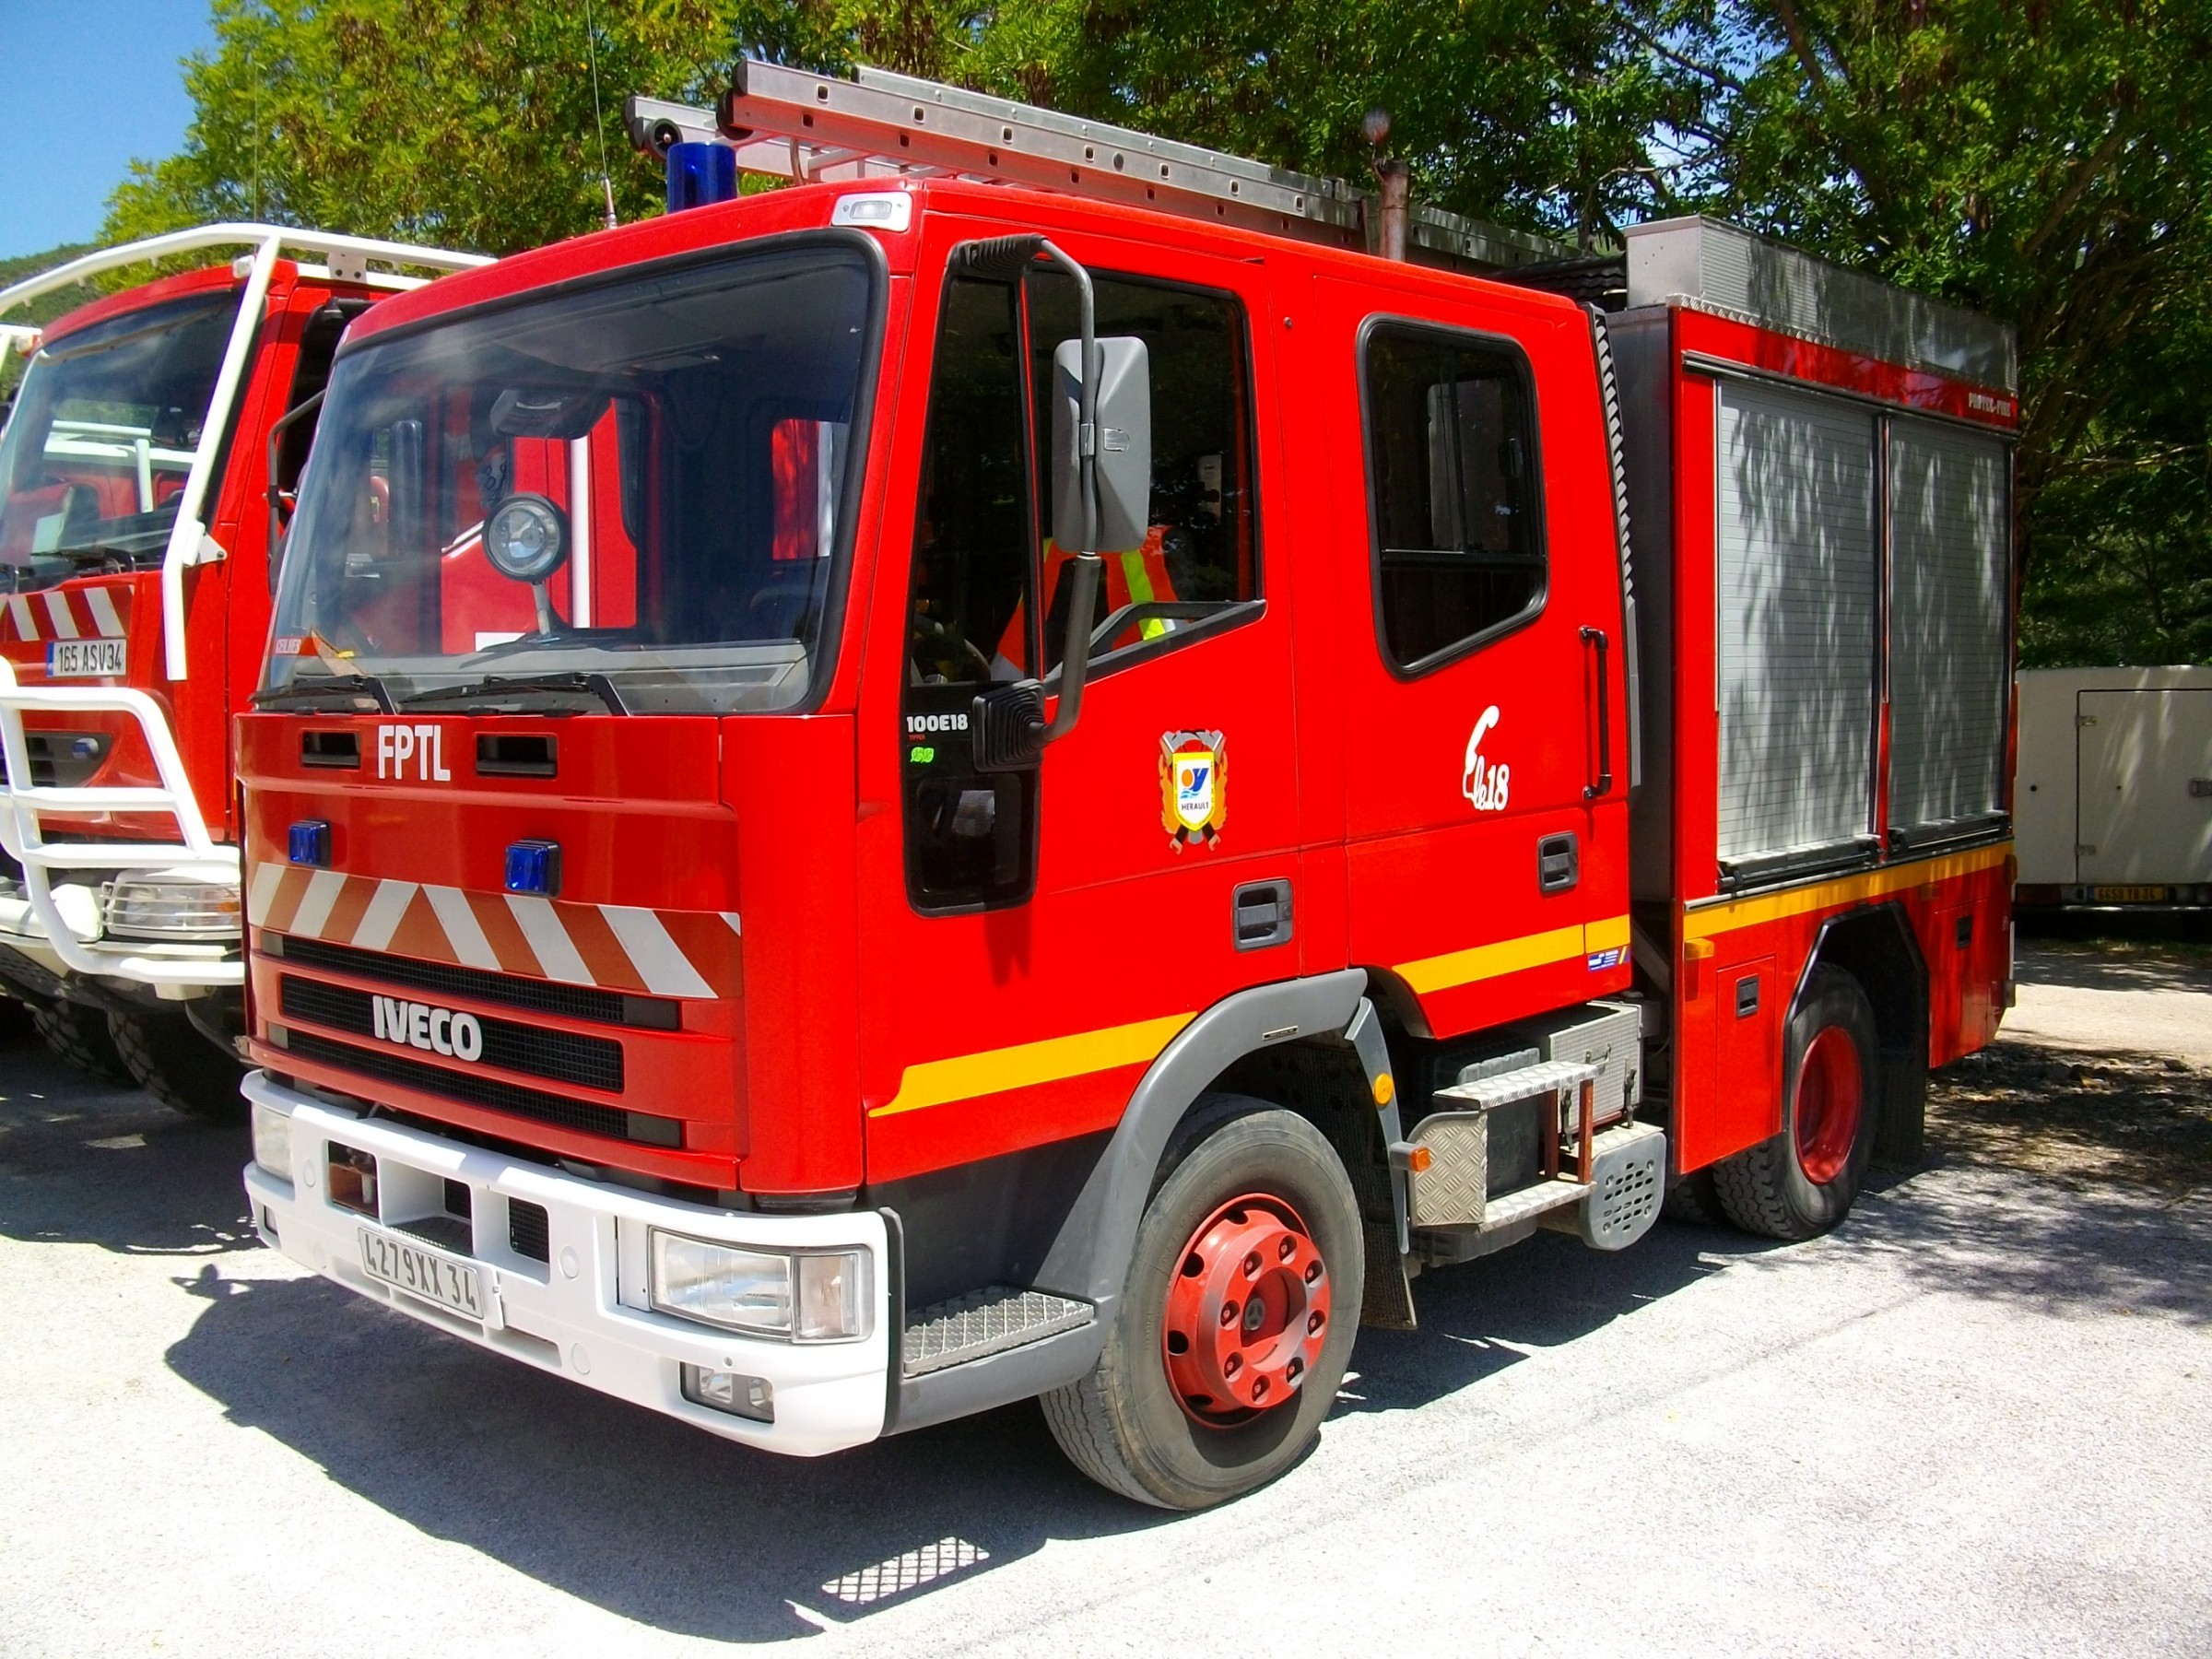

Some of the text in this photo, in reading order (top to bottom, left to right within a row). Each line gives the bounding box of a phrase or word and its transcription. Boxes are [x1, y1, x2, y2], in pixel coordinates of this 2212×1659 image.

[59, 645, 78, 672] 165
[906, 713, 969, 733] 100E18
[378, 724, 452, 782] FPTL
[1181, 801, 1209, 811] HERAULT
[1486, 763, 1510, 811] 18
[372, 994, 483, 1062] IVECO
[446, 1265, 477, 1312] 34
